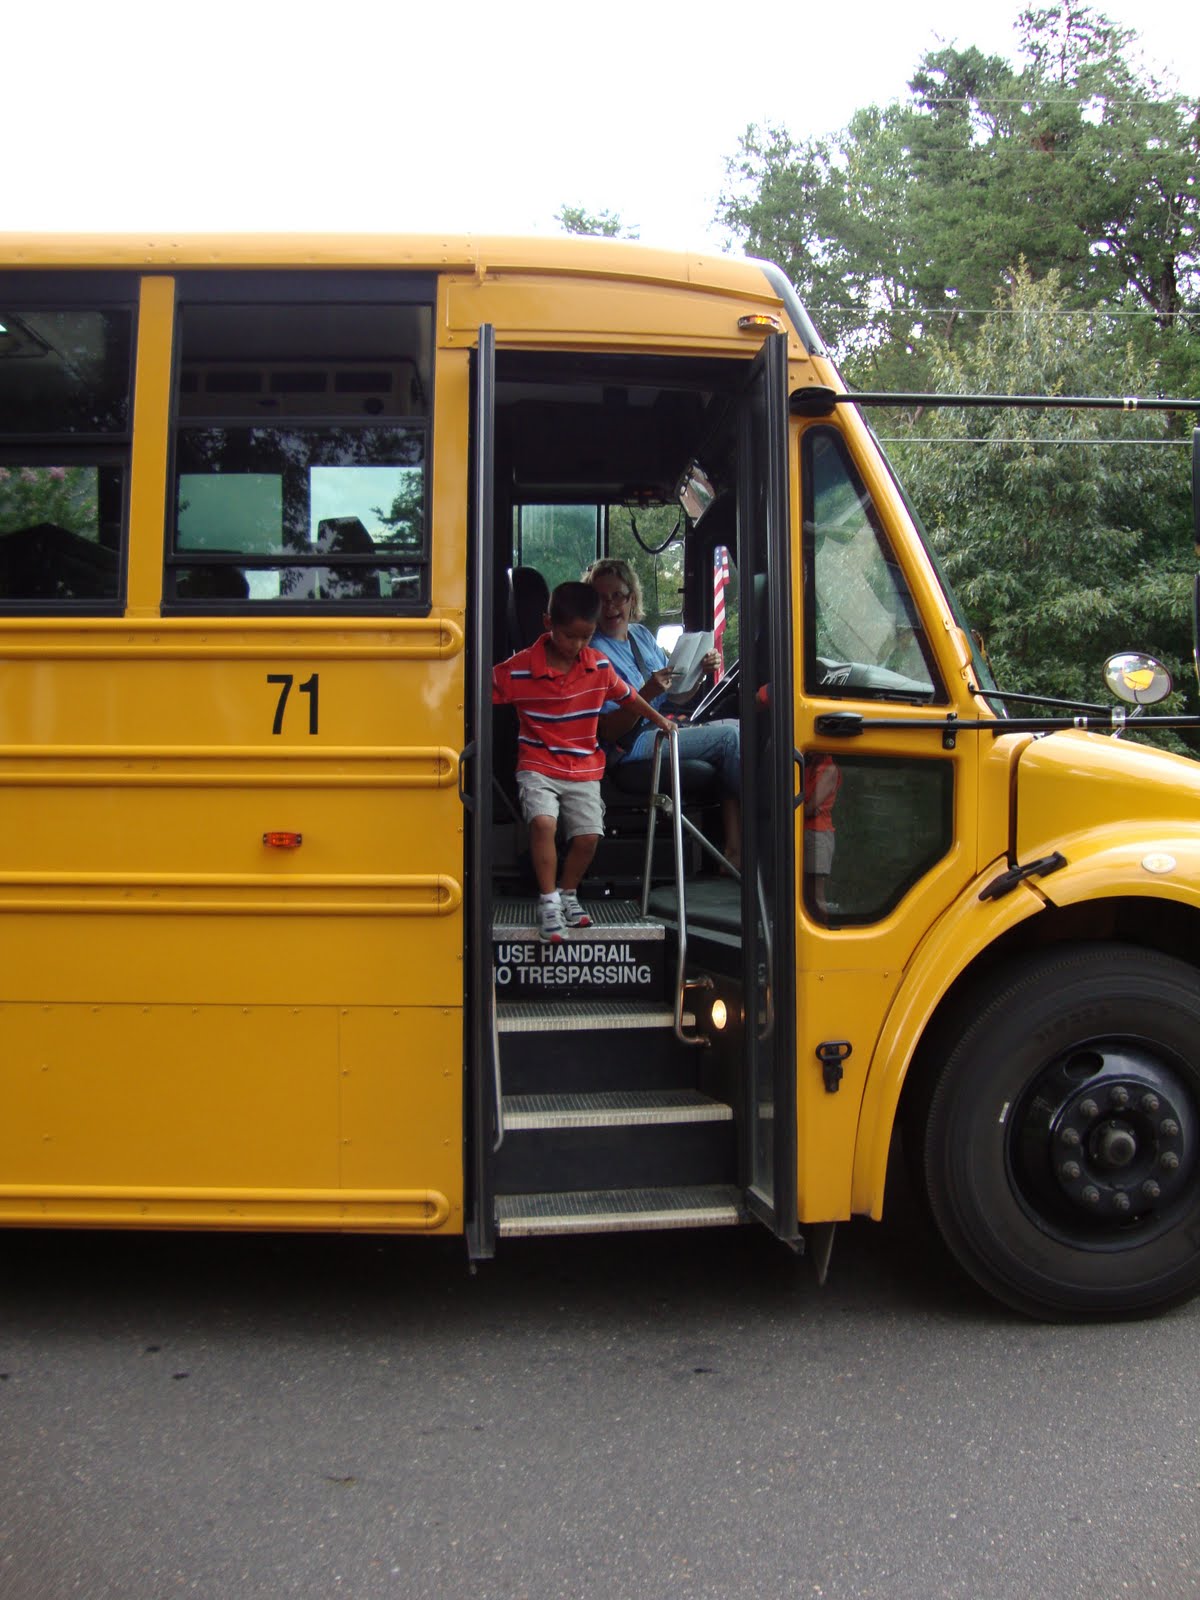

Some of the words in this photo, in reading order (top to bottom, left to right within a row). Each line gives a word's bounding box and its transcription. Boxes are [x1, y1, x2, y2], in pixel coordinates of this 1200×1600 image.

[267, 674, 319, 735] 71
[499, 945, 535, 963] USE
[542, 945, 635, 963] HANDRAIL
[494, 966, 511, 984] O
[517, 966, 650, 984] TRESPASSING
